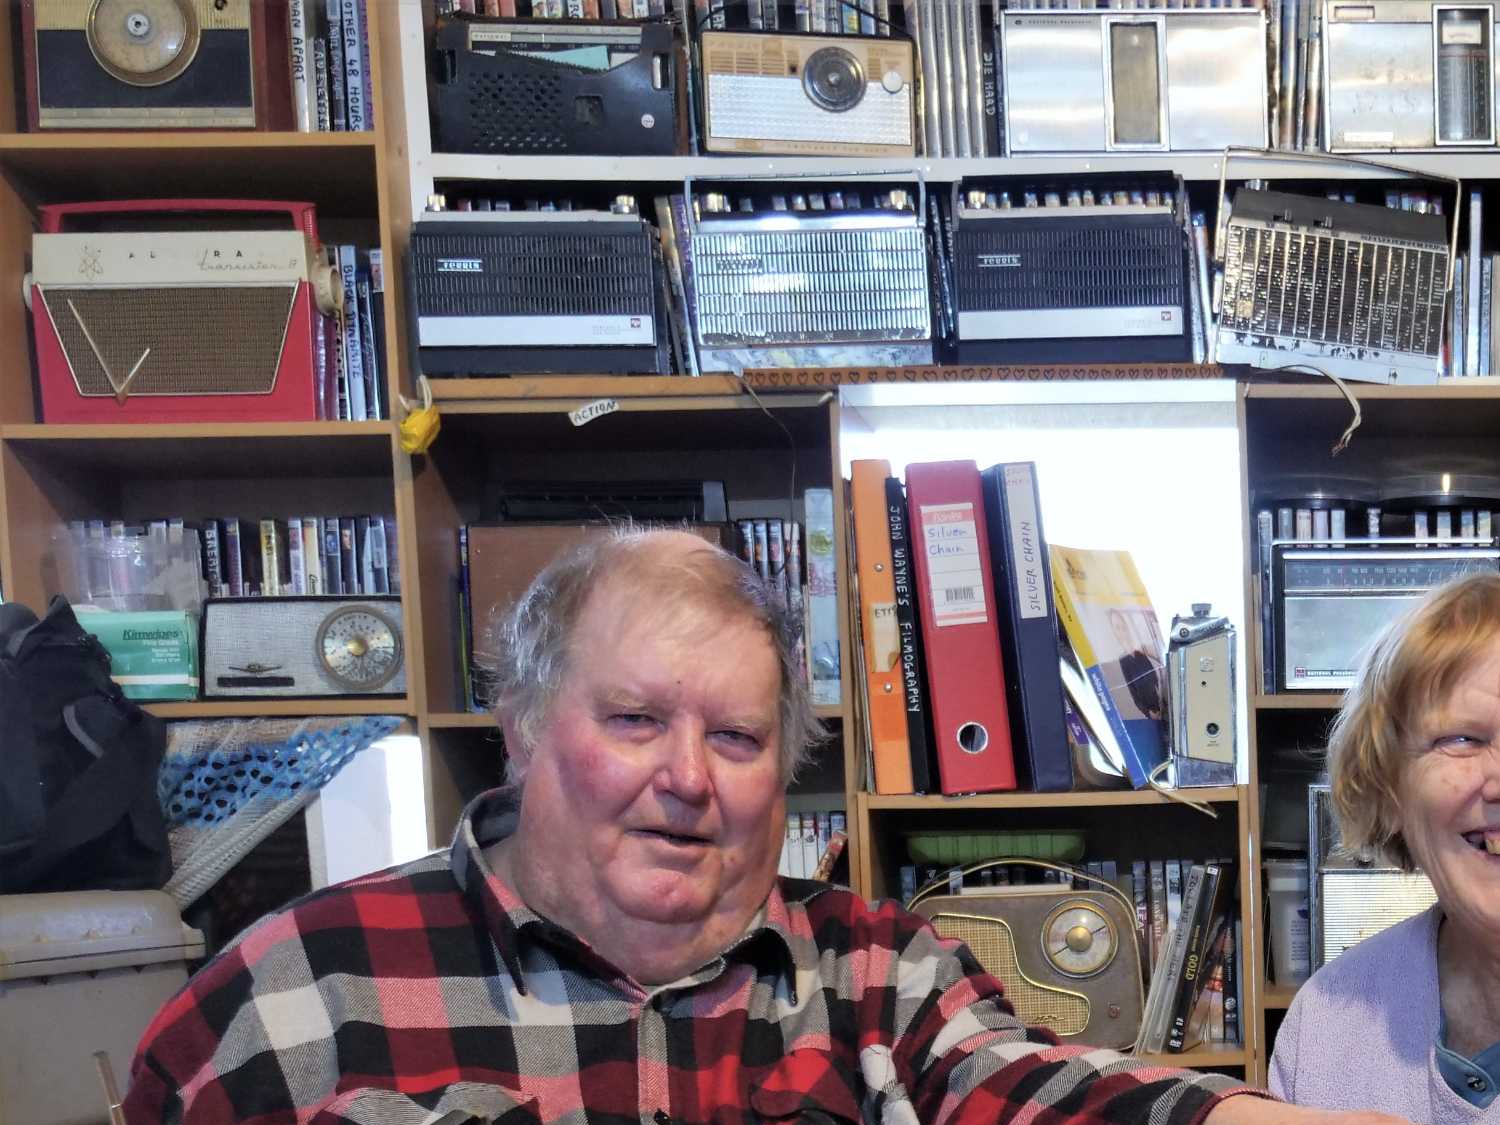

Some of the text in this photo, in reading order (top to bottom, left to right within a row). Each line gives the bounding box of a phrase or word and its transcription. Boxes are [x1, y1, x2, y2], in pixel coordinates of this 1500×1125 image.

[293, 37, 305, 82] APART
[347, 59, 359, 77] 48
[983, 52, 996, 115] DIE HARD
[350, 86, 362, 131] HOURS
[343, 265, 355, 304] BLACK
[574, 400, 616, 422] ACTION
[927, 527, 968, 539] Silver
[1021, 521, 1041, 611] SILVER CHAIN
[890, 506, 920, 712] JOHN WAYNE'S FILMOGRAPHY
[1185, 954, 1199, 980] GOLD
